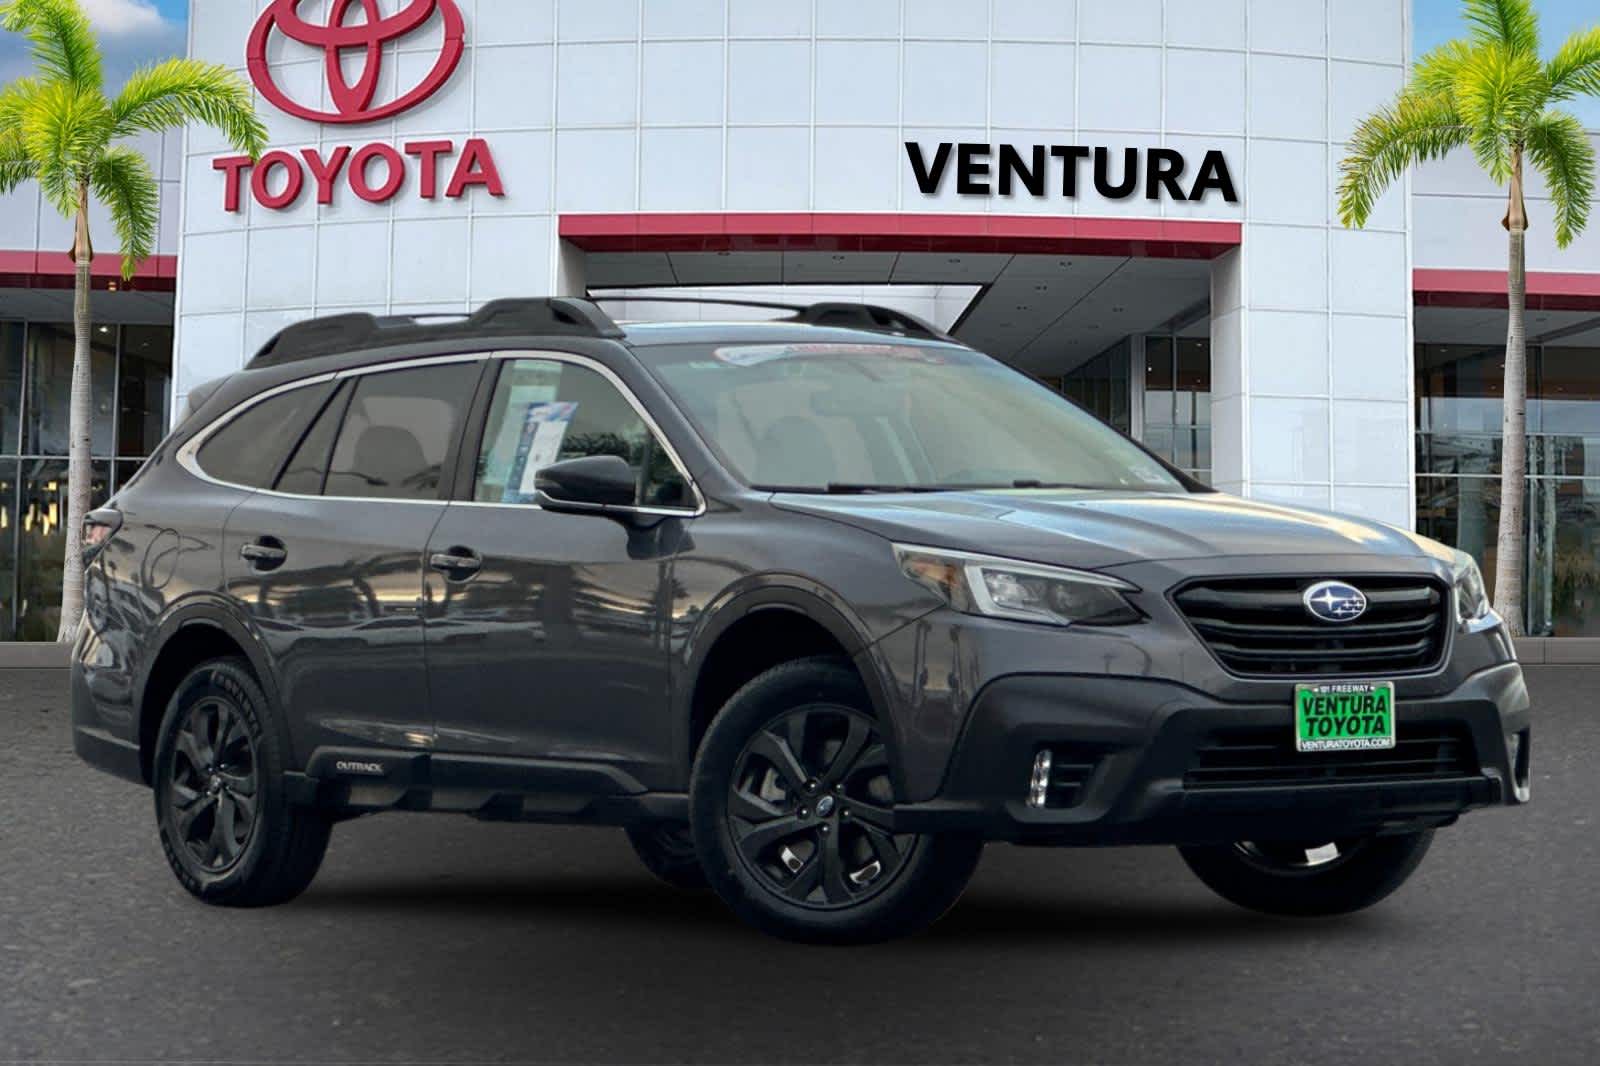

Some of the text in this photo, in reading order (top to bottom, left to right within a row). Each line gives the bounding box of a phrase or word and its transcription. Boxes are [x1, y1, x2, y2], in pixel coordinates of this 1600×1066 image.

[212, 138, 505, 212] TOYOTA
[904, 141, 1239, 203] VENTURA
[1331, 685, 1369, 693] FREEWAY
[1302, 695, 1386, 715] VENTURA
[1305, 715, 1386, 737] TOYOTA
[1301, 739, 1390, 749] VENTURATOYOTA.COM
